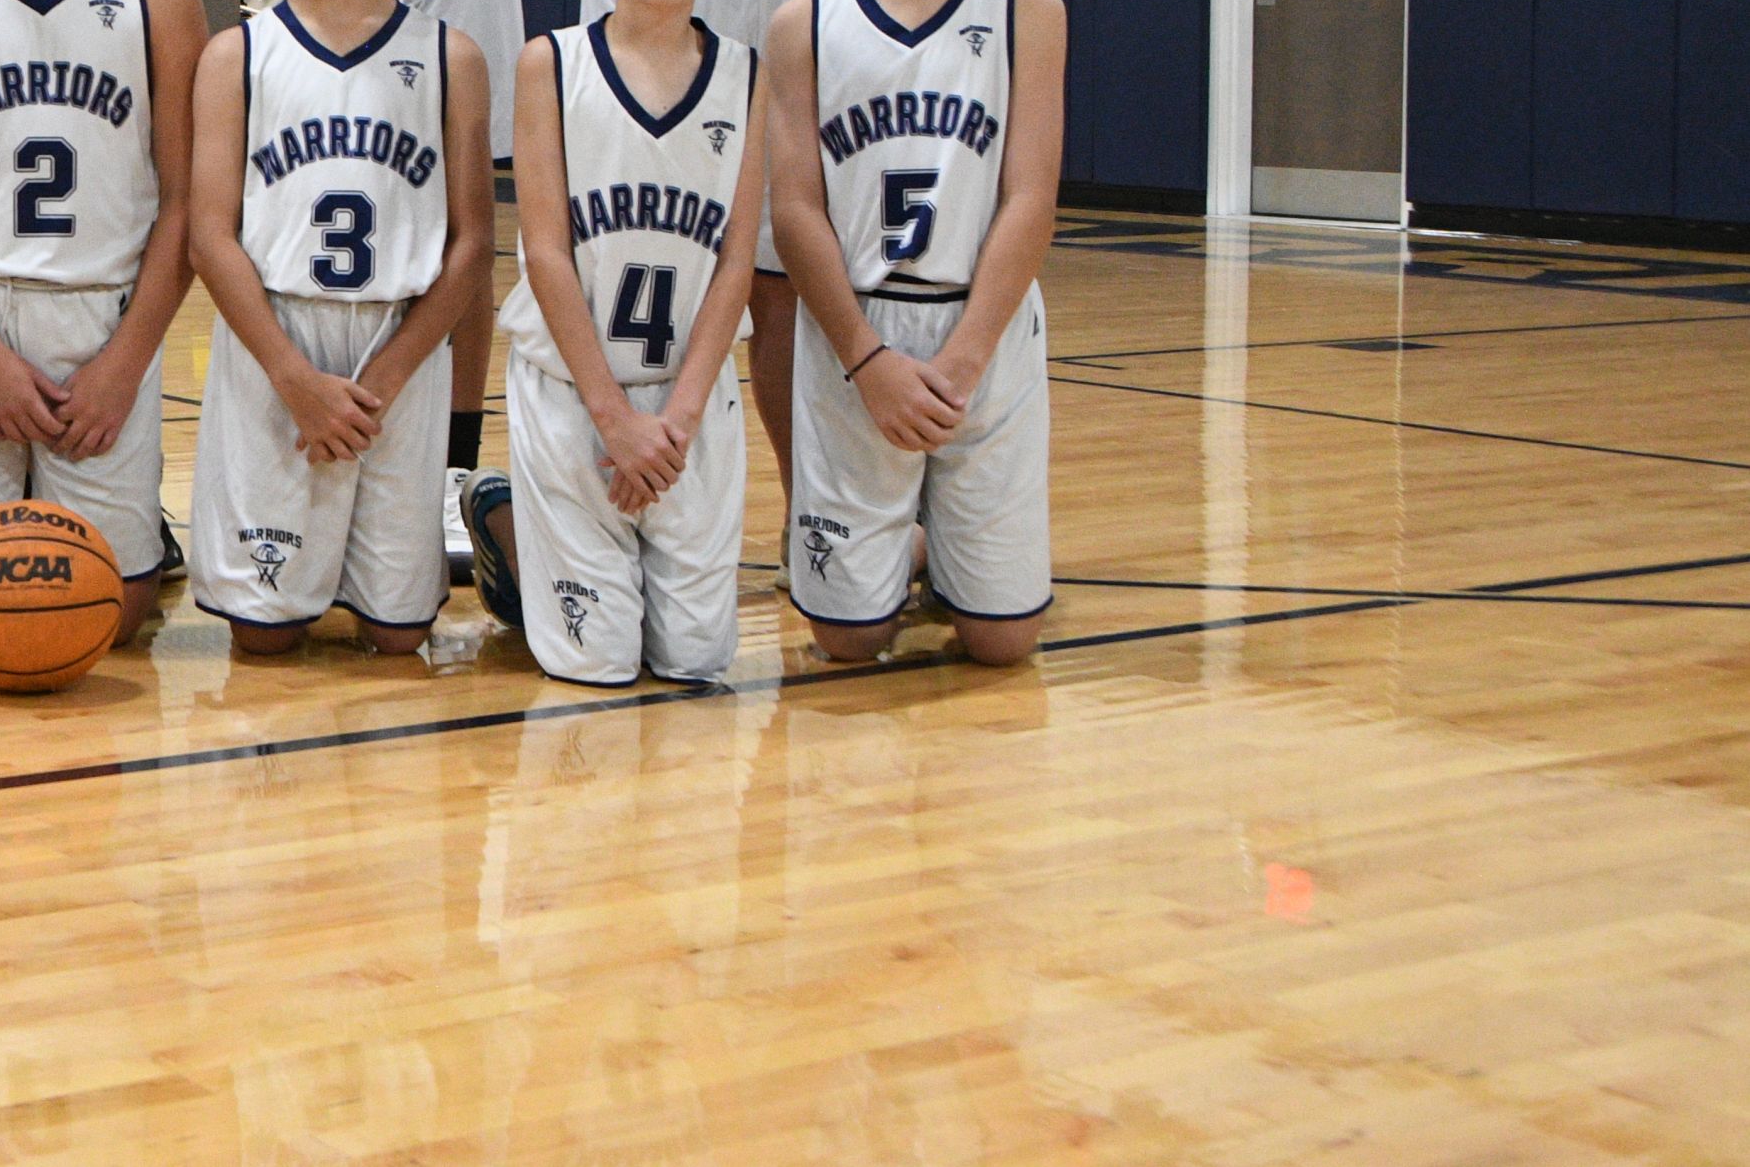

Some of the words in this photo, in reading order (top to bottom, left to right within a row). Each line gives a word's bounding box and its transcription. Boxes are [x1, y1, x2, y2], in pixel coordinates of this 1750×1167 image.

[251, 115, 437, 189] WARRIORS
[820, 91, 999, 166] WARRIORS
[14, 137, 77, 237] 2
[570, 182, 728, 256] WARRIOR
[881, 169, 940, 265] 5
[310, 190, 376, 292] 3
[607, 263, 677, 368] 4
[238, 528, 303, 549] WARRIORS
